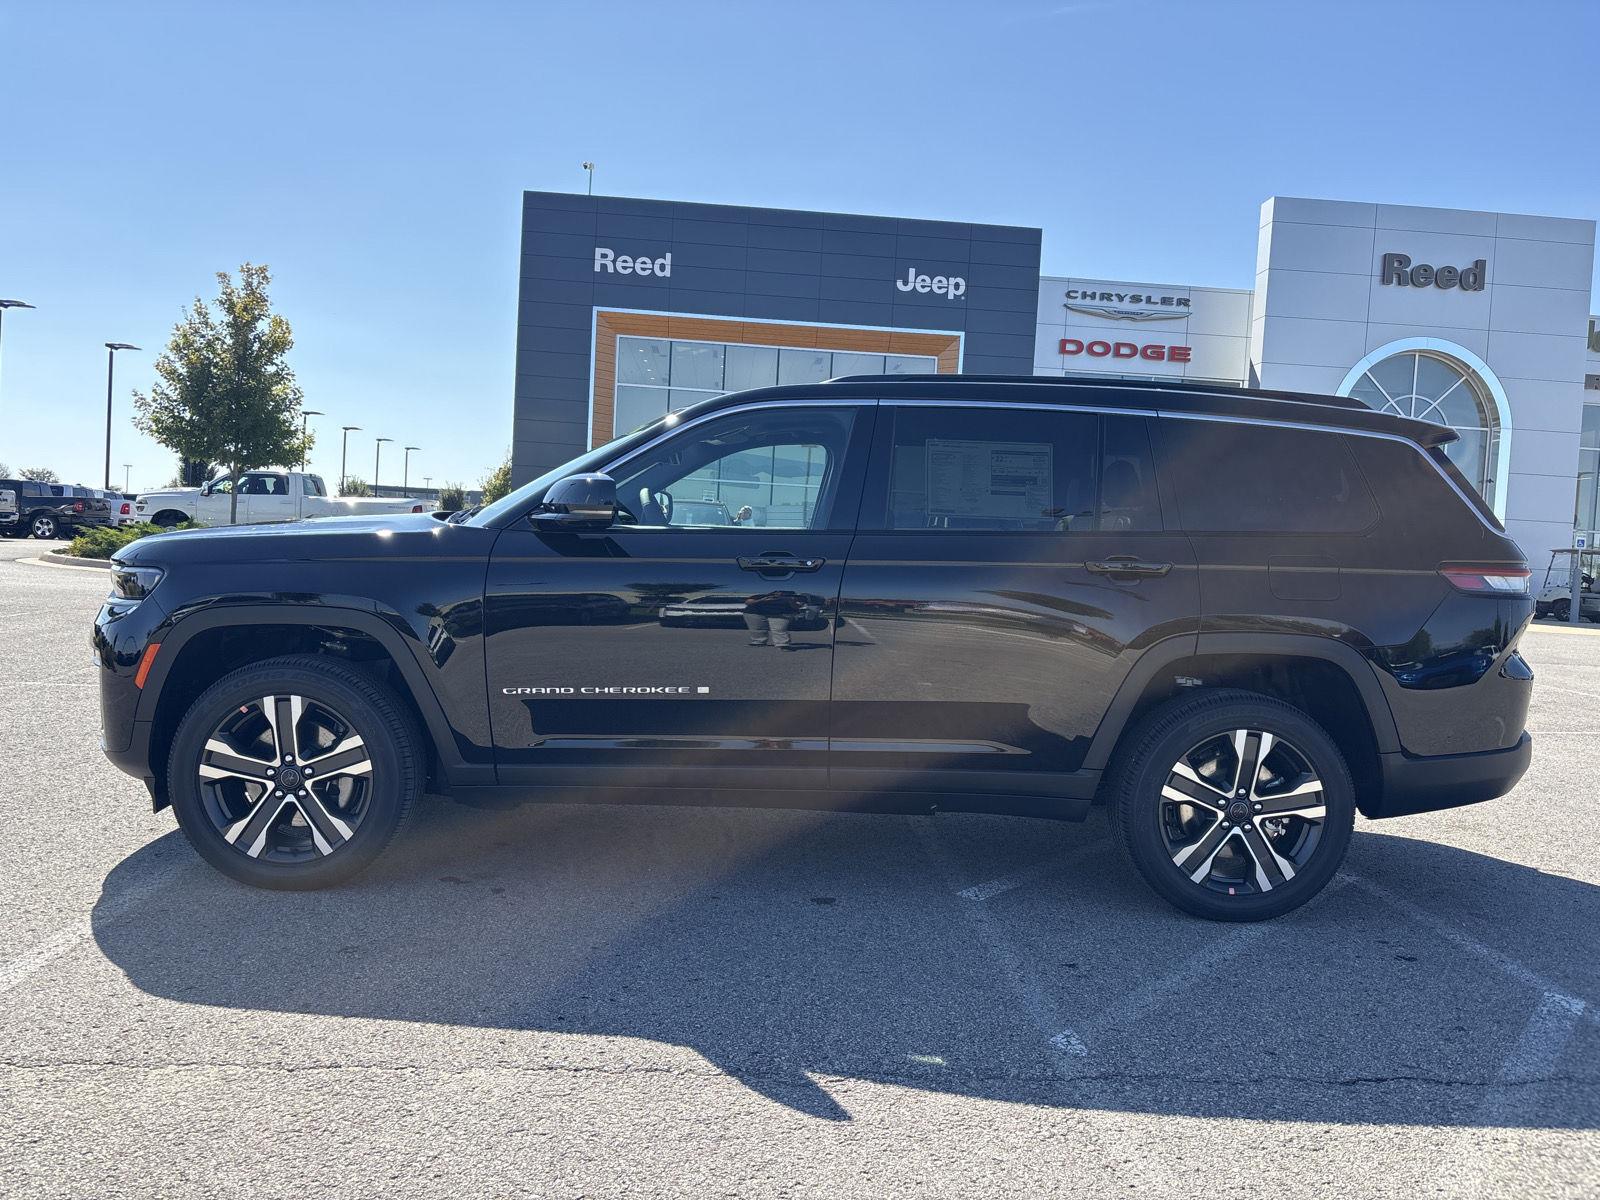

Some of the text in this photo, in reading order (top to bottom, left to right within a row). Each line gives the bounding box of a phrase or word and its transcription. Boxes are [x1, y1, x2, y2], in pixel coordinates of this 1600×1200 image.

[594, 247, 672, 277] Reed
[1382, 252, 1487, 291] Reed
[896, 267, 966, 300] Jeep
[1065, 289, 1191, 307] CHRYSLER
[1058, 338, 1192, 363] DODGE
[502, 686, 691, 695] GRAND CHEROKEE
